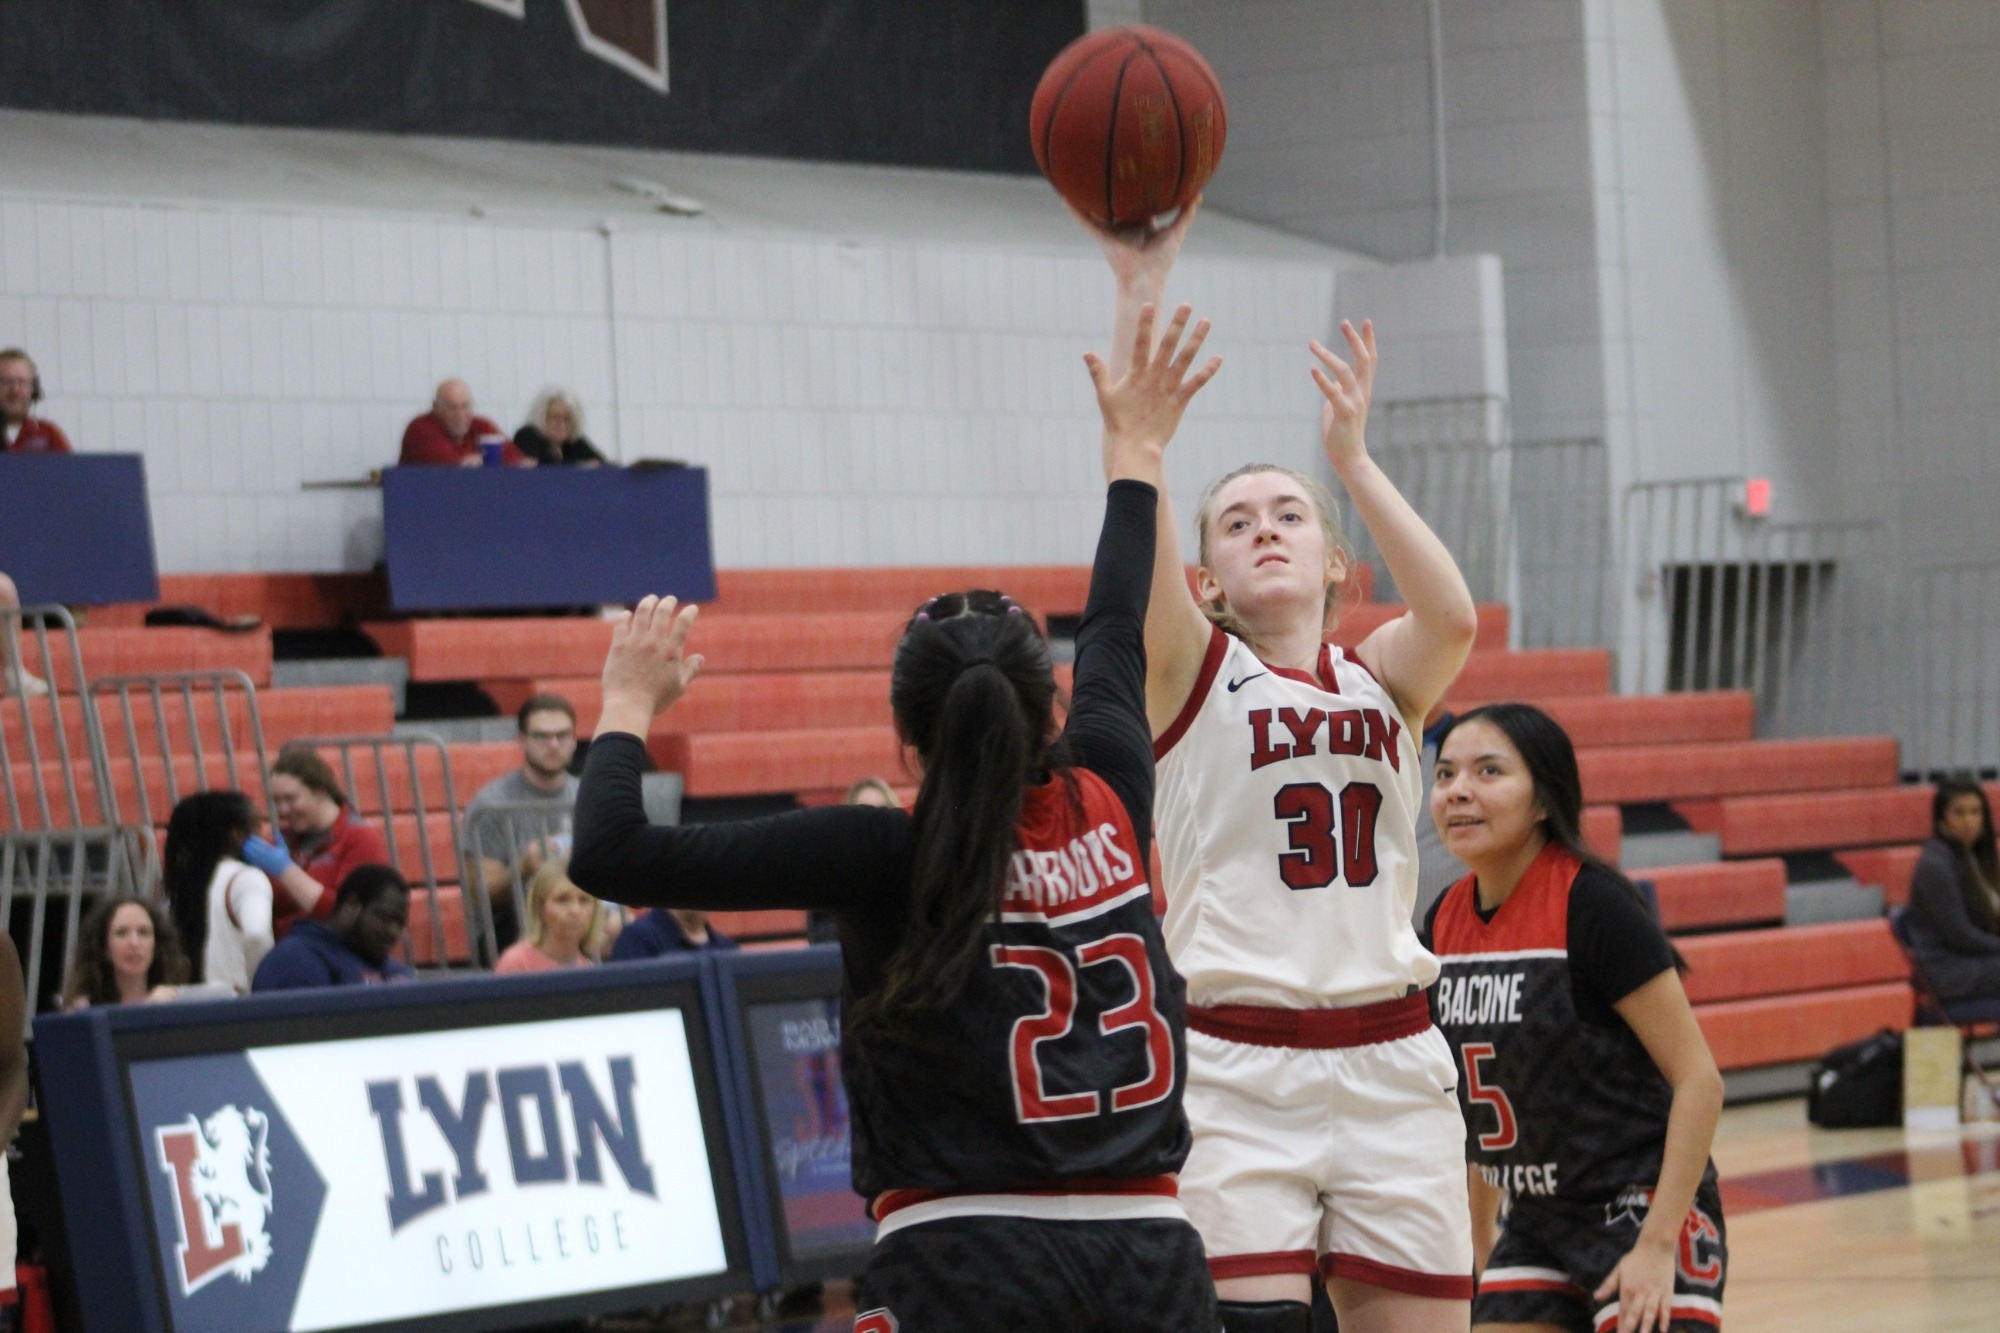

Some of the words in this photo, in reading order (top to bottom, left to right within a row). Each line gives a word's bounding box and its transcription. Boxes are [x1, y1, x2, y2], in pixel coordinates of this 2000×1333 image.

[1248, 706, 1402, 775] LYON
[1005, 822, 1135, 907] ARRIORS
[1273, 781, 1384, 891] 30
[988, 932, 1176, 1125] 23
[1438, 973, 1525, 1026] BACONE
[1460, 1041, 1518, 1151] 5
[365, 1053, 662, 1239] LYON
[1471, 1161, 1558, 1196] OLLEGE
[435, 1210, 632, 1276] COLLEGE
